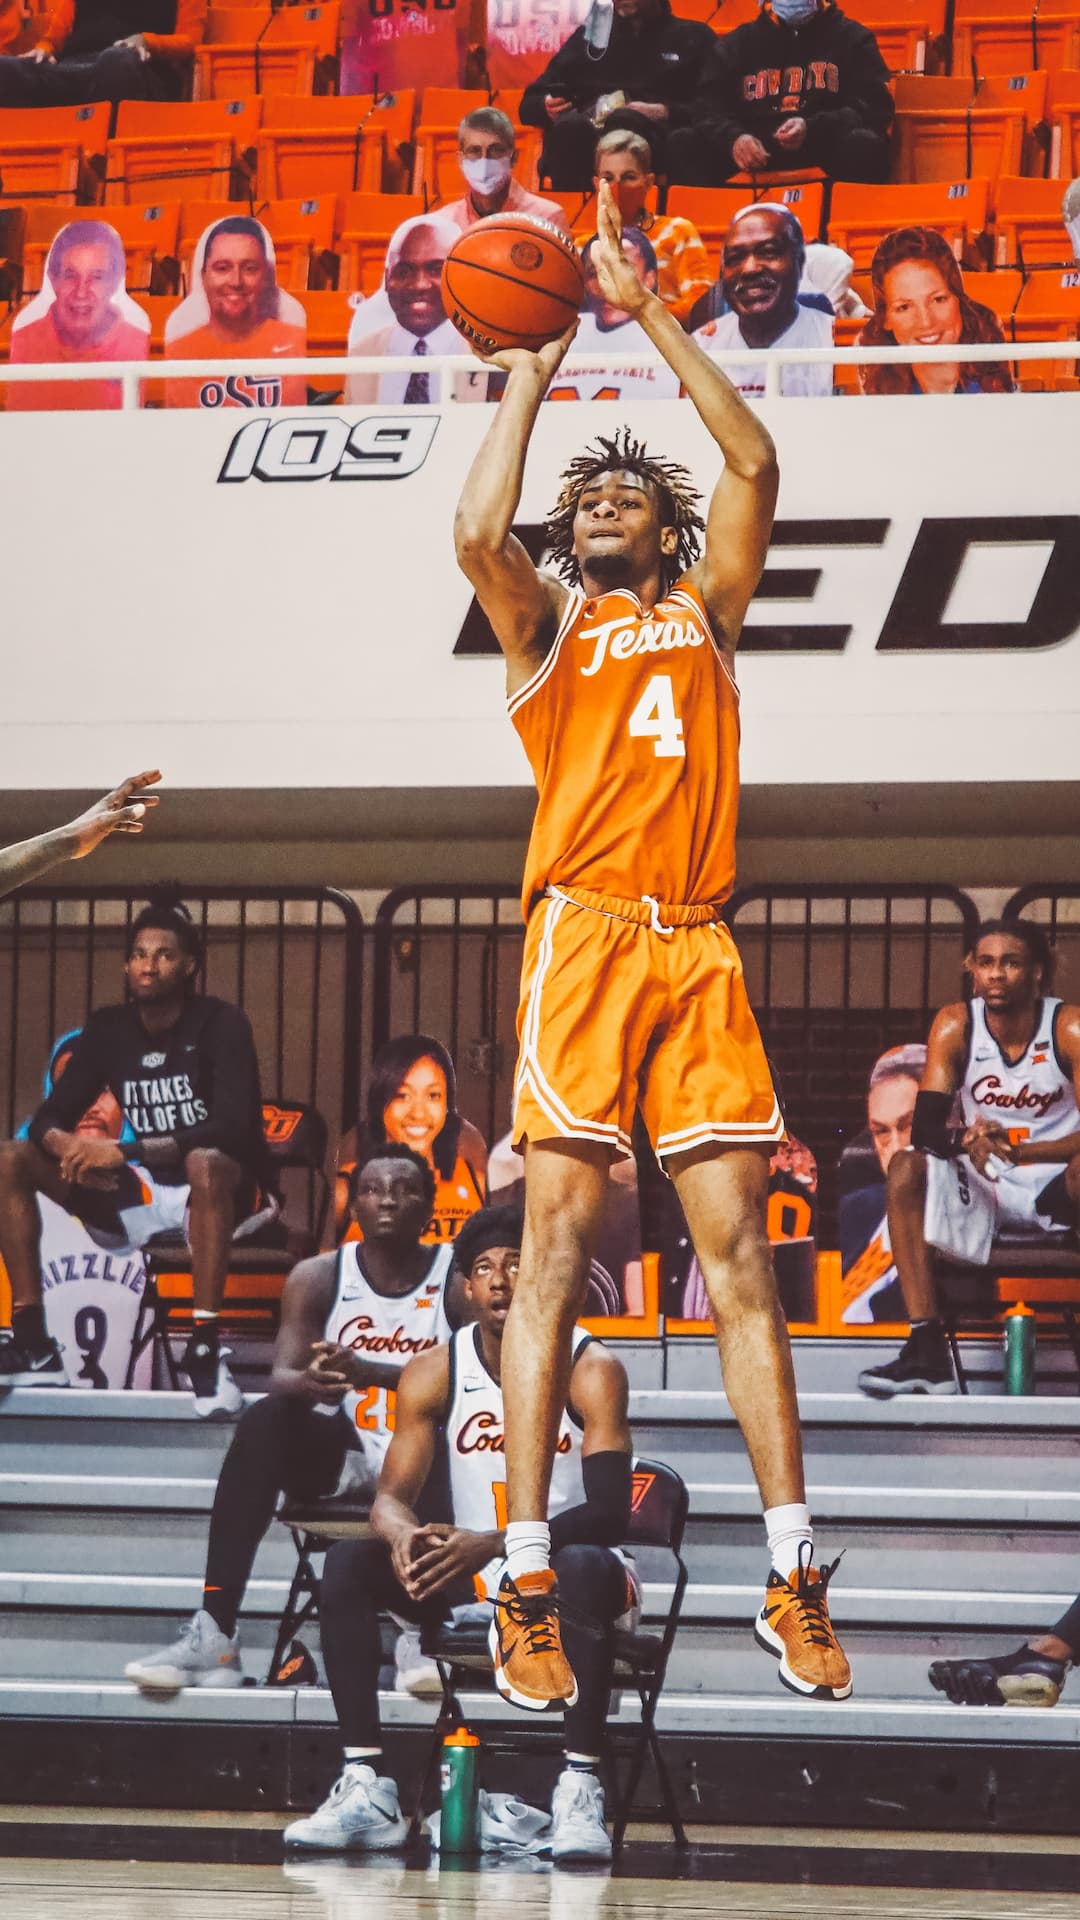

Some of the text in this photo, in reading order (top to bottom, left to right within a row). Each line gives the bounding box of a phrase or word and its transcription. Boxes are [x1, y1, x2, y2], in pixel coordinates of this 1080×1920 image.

[217, 415, 441, 483] 109
[452, 515, 1080, 654] ED
[578, 616, 705, 676] Texas
[628, 674, 686, 758] 4
[123, 1073, 194, 1106] IT TAKES
[153, 1104, 177, 1132] OF
[181, 1099, 209, 1127] US
